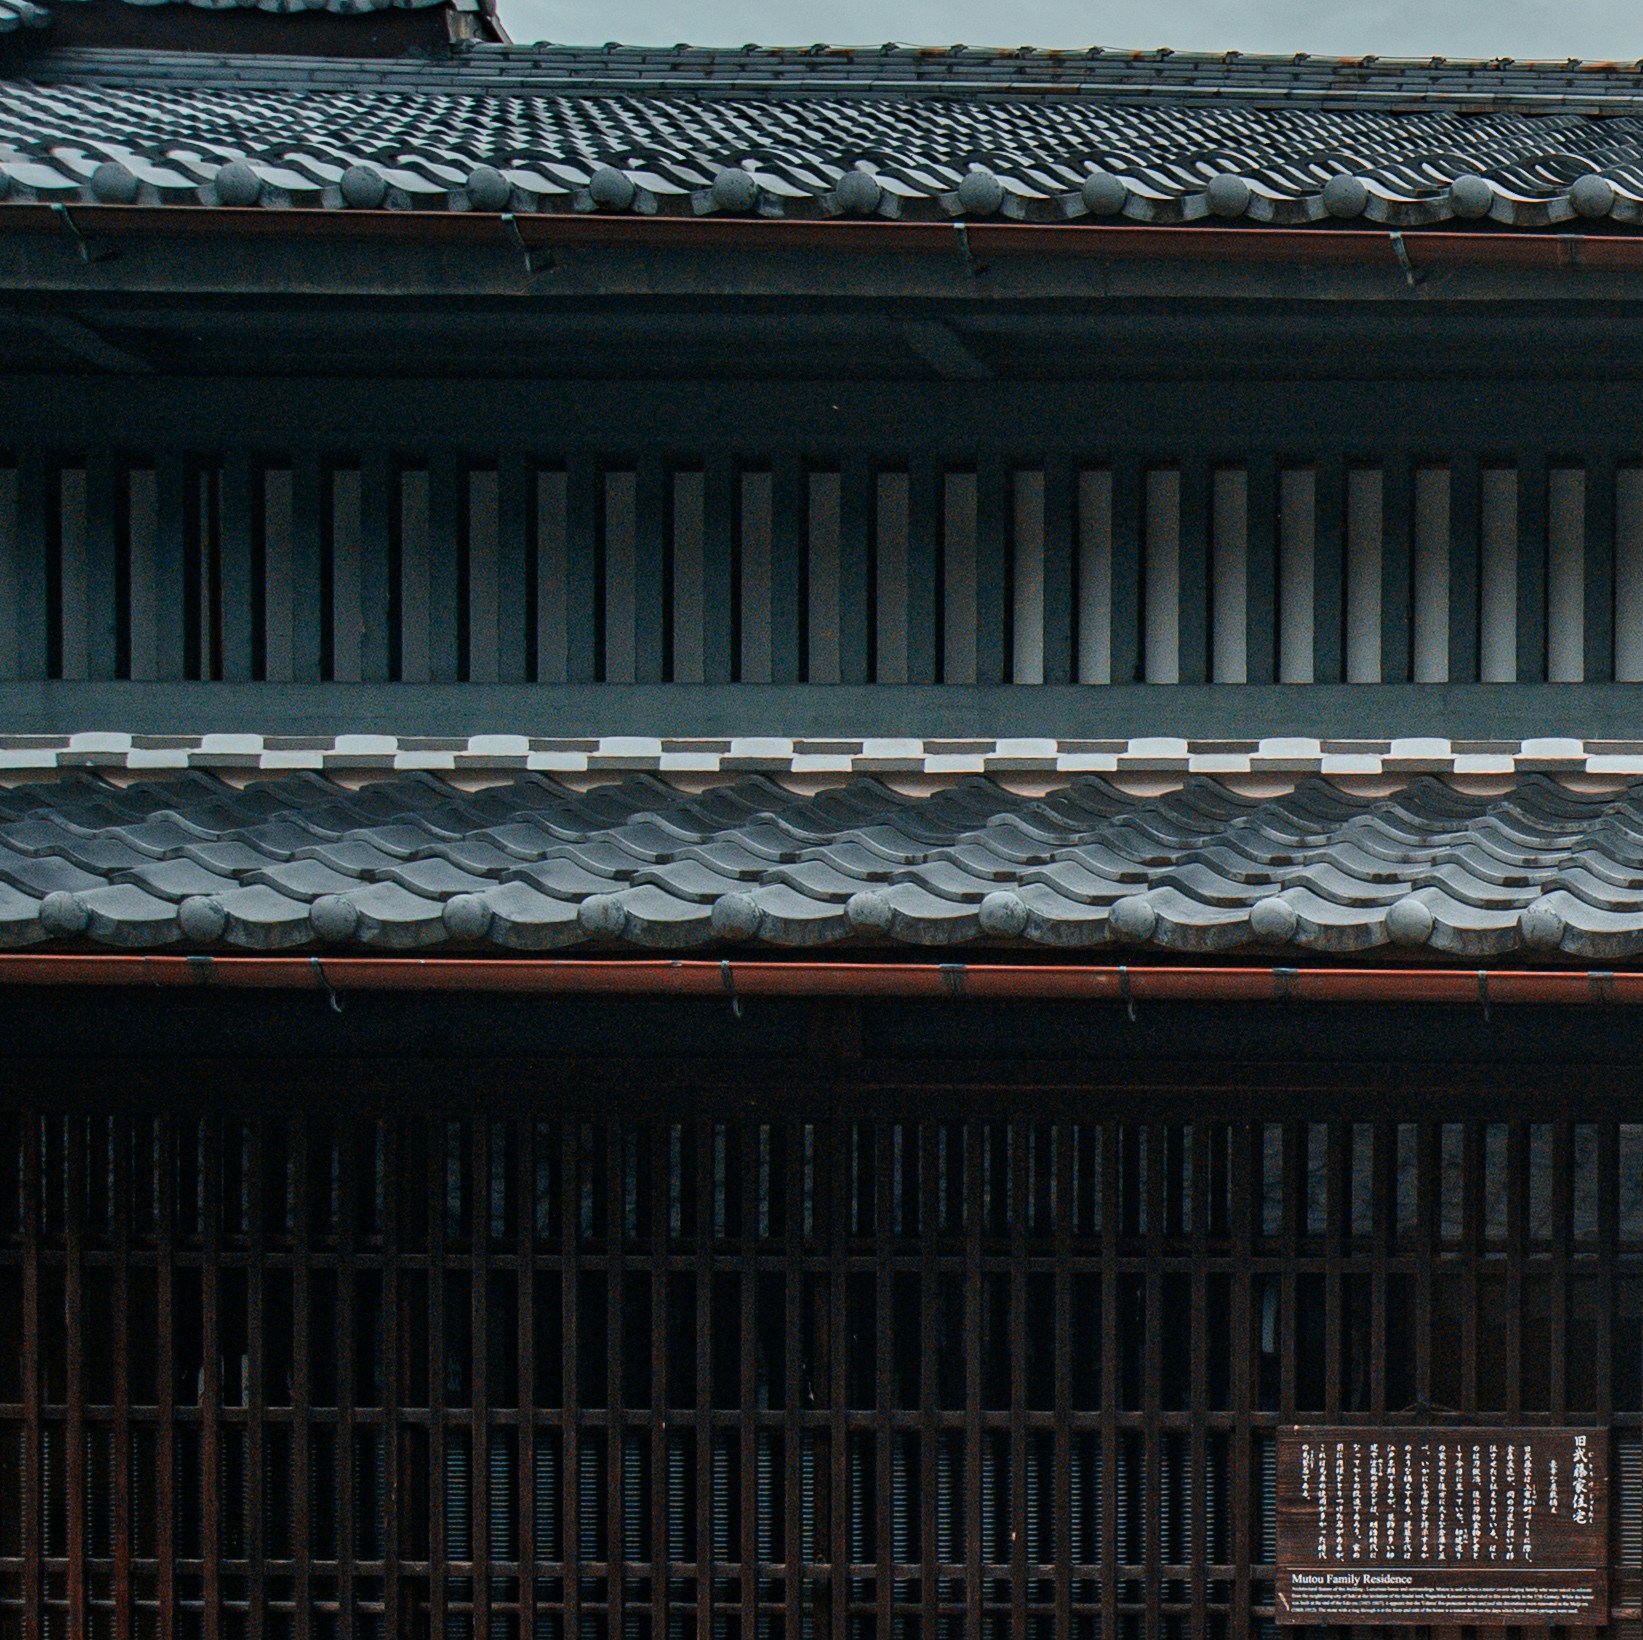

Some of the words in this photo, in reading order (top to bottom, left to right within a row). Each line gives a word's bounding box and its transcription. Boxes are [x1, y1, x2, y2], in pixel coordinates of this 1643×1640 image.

[1572, 1435, 1588, 1525] 旧武藤家住宅
[1291, 1574, 1324, 1584] Mutou
[1326, 1574, 1361, 1587] Family
[1363, 1574, 1413, 1584] Residence
